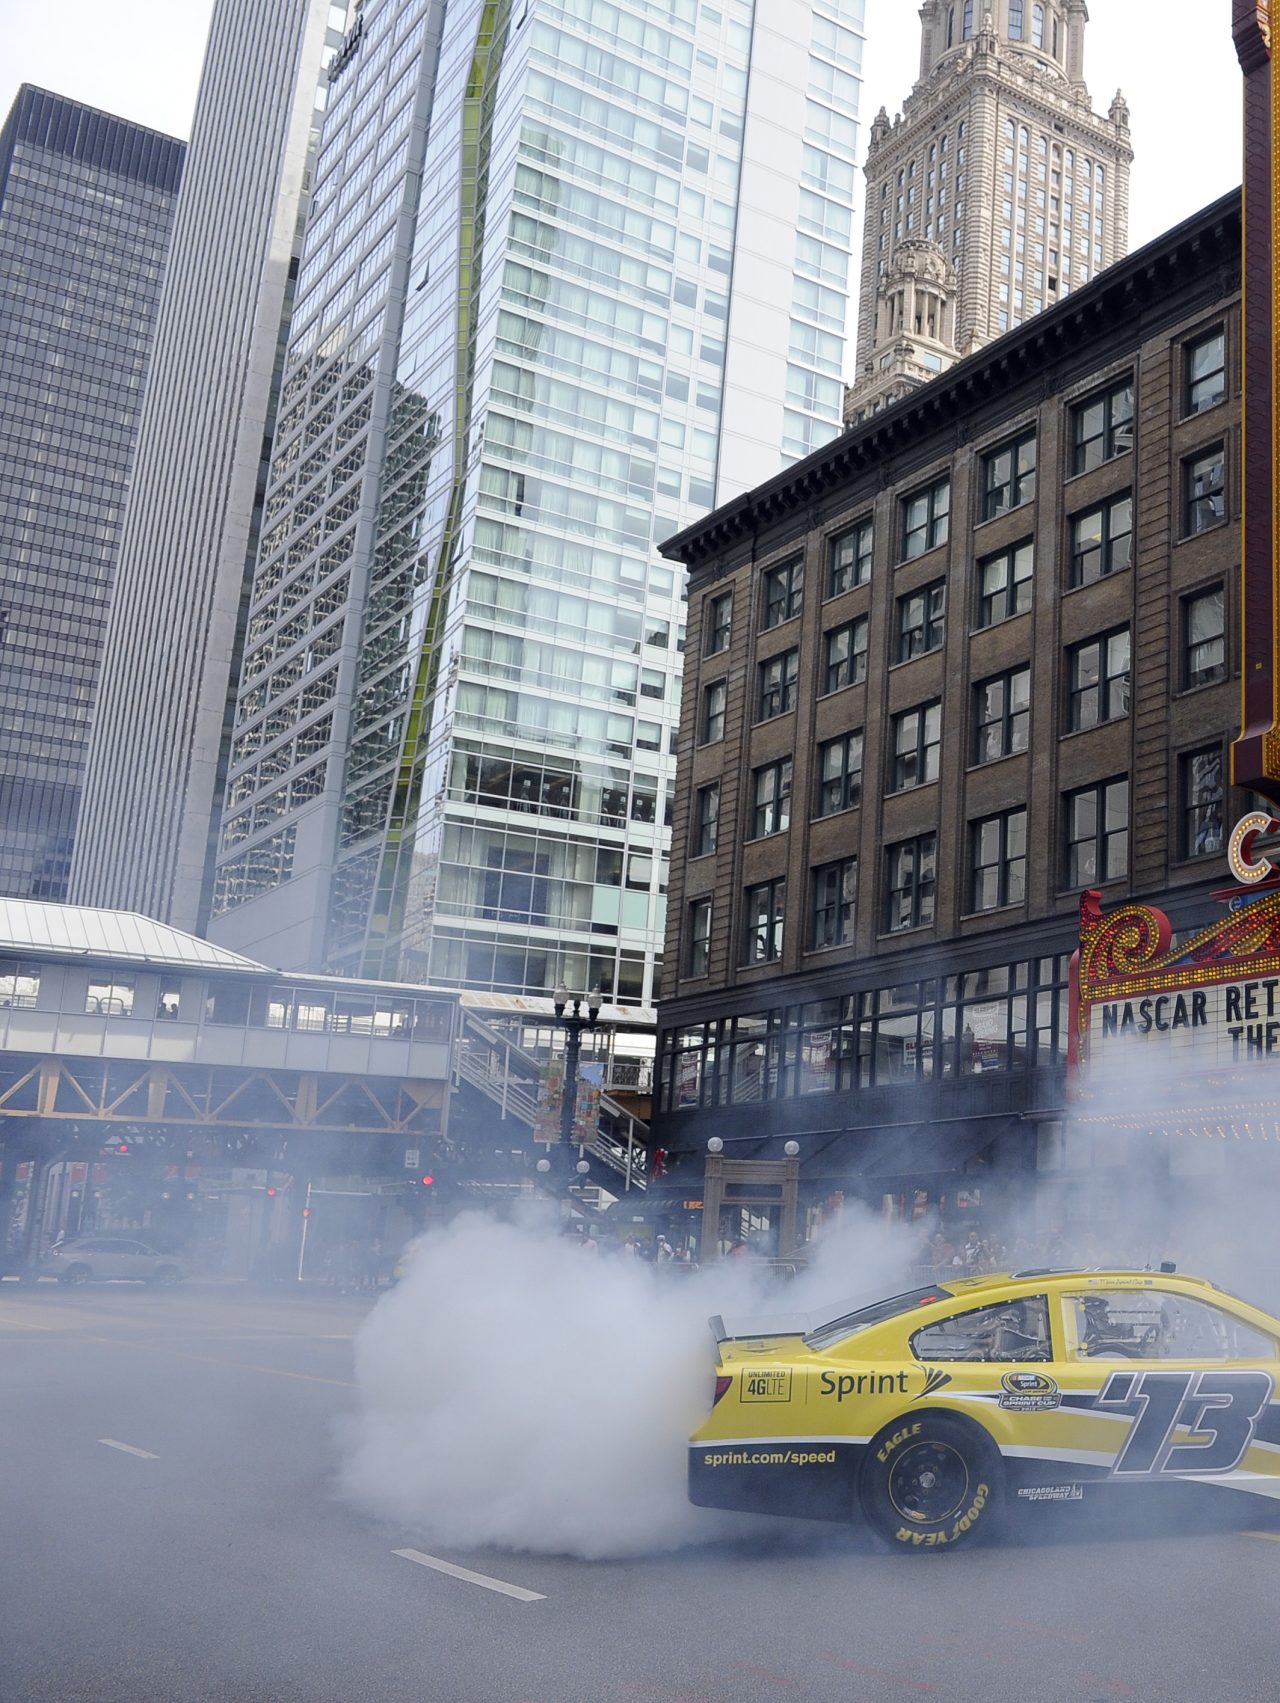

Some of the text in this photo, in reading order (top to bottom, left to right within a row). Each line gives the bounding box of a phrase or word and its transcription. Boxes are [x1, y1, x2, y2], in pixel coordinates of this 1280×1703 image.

[1101, 990, 1208, 1039] NASCAR
[1230, 1021, 1280, 1062] THE
[820, 1370, 909, 1402] Sprint
[876, 1422, 922, 1463] EAGLE
[1093, 1370, 1275, 1479] 13
[703, 1449, 836, 1468] sprint.com/speed
[1018, 1486, 1070, 1494] CHICAGOLAND
[895, 1483, 989, 1546] GOODYEAR
